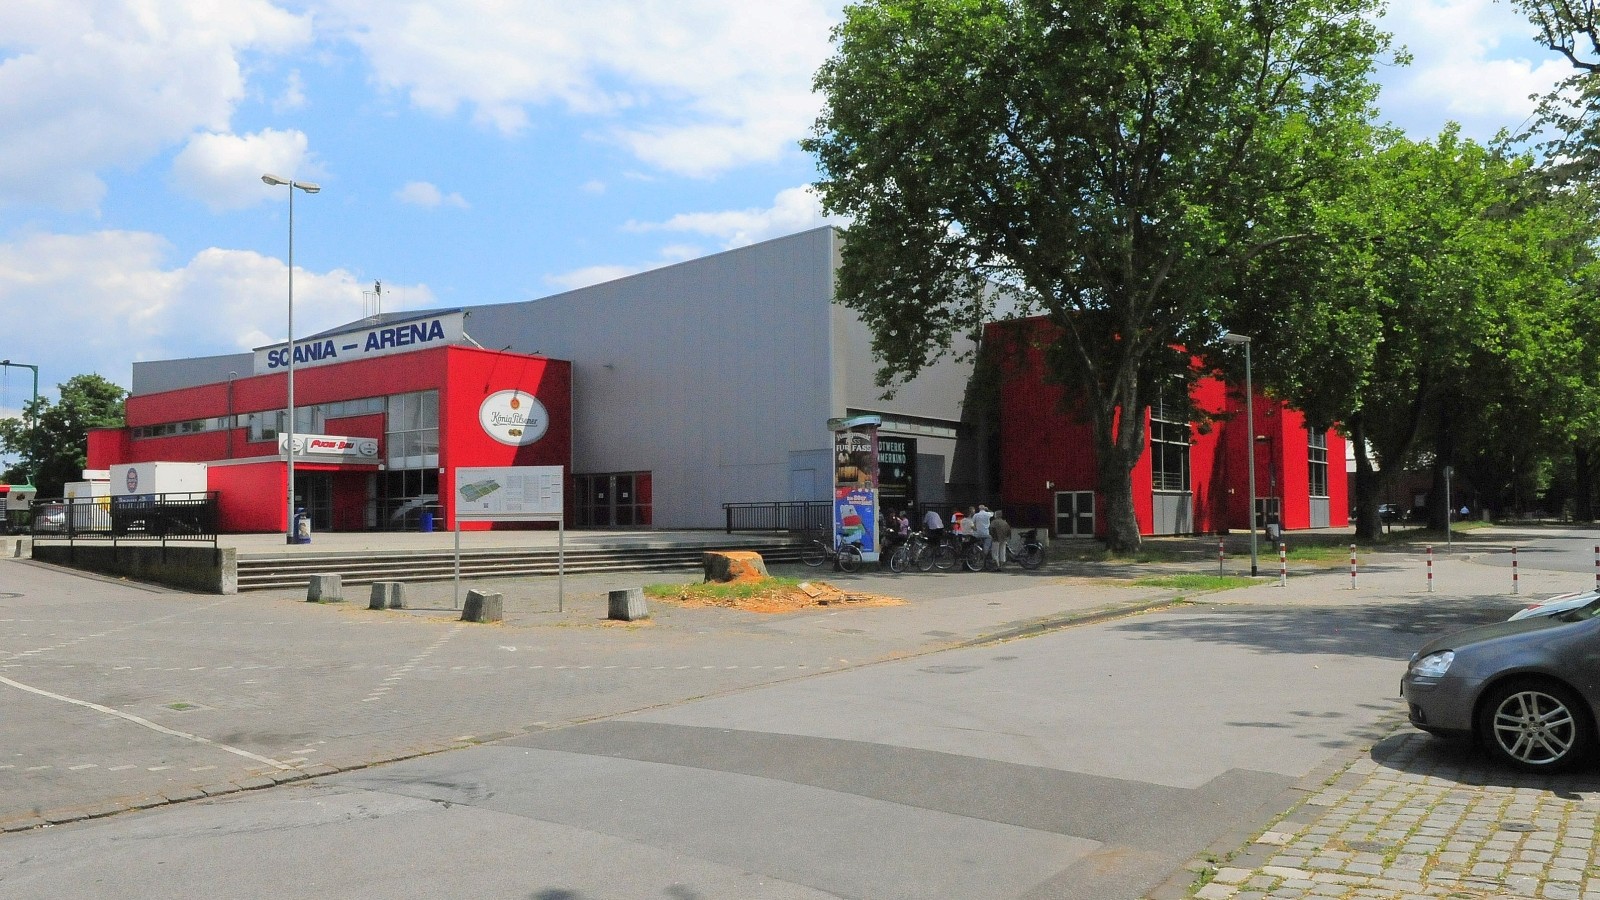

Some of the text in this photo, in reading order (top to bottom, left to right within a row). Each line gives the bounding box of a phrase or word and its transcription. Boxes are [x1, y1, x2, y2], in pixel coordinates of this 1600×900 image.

[267, 340, 337, 369] SCANIA
[364, 319, 445, 352] ARENA
[852, 444, 872, 452] FASS
[878, 441, 905, 453] DTWERKE
[877, 452, 907, 464] MERKINO
